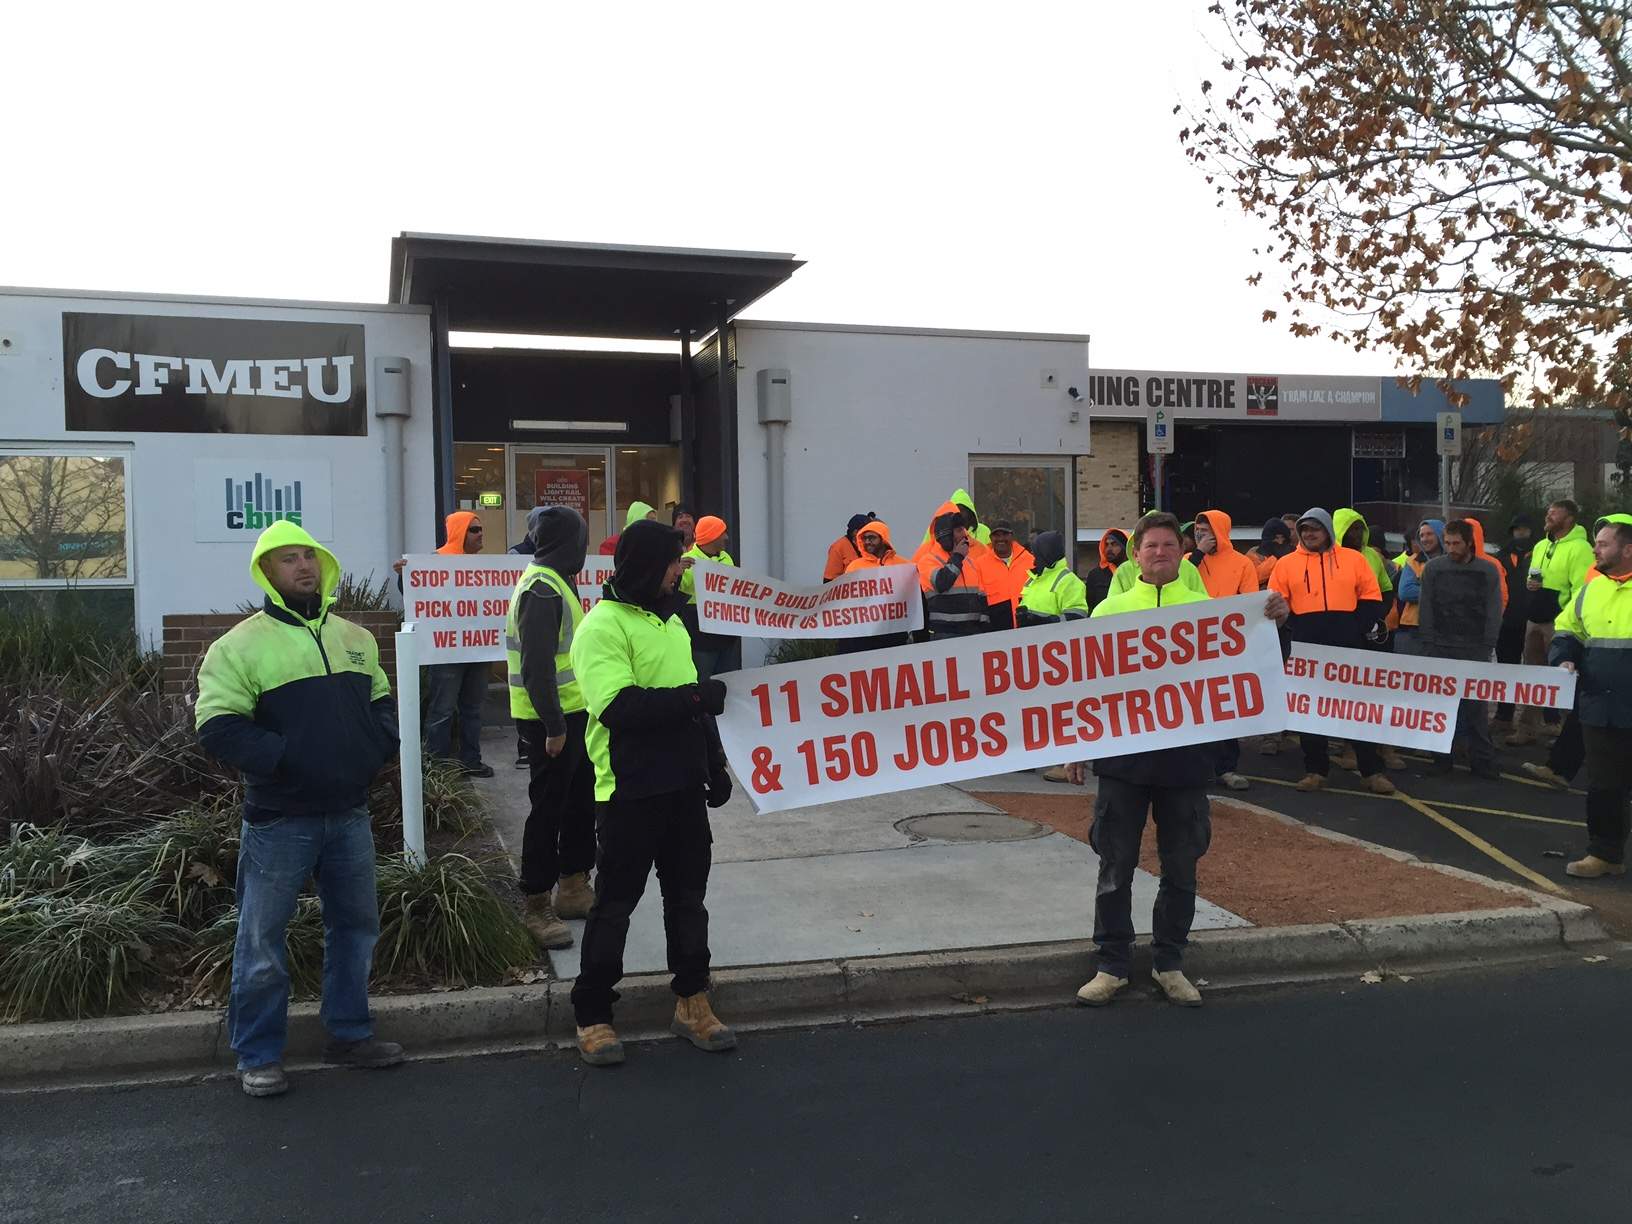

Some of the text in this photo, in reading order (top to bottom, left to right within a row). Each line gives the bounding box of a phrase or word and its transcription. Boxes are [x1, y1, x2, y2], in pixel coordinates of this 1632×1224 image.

[76, 347, 354, 403] CFMEU
[1146, 377, 1235, 408] CENTRE
[483, 495, 497, 504] EXIT
[226, 502, 302, 529] cbus
[411, 570, 449, 588] STOP
[705, 572, 894, 609] WE HELP BUILD CANBERRA!
[415, 600, 452, 618] PICK
[456, 600, 478, 617] ON
[703, 600, 750, 624] CFMEU
[754, 608, 799, 629] WANT
[799, 612, 818, 629] US
[822, 601, 908, 628] DESTROYED!
[433, 629, 500, 649] WE HAVE
[750, 612, 1247, 728] 11 SMALL BUSINESSES
[1324, 661, 1457, 698] COLLECTORS
[1463, 678, 1507, 703] FOR
[1514, 682, 1560, 707] NOT
[1317, 696, 1384, 725] UNION
[1390, 705, 1448, 734] DUES
[750, 672, 1266, 795] & 150 JOBS DESTROYED
